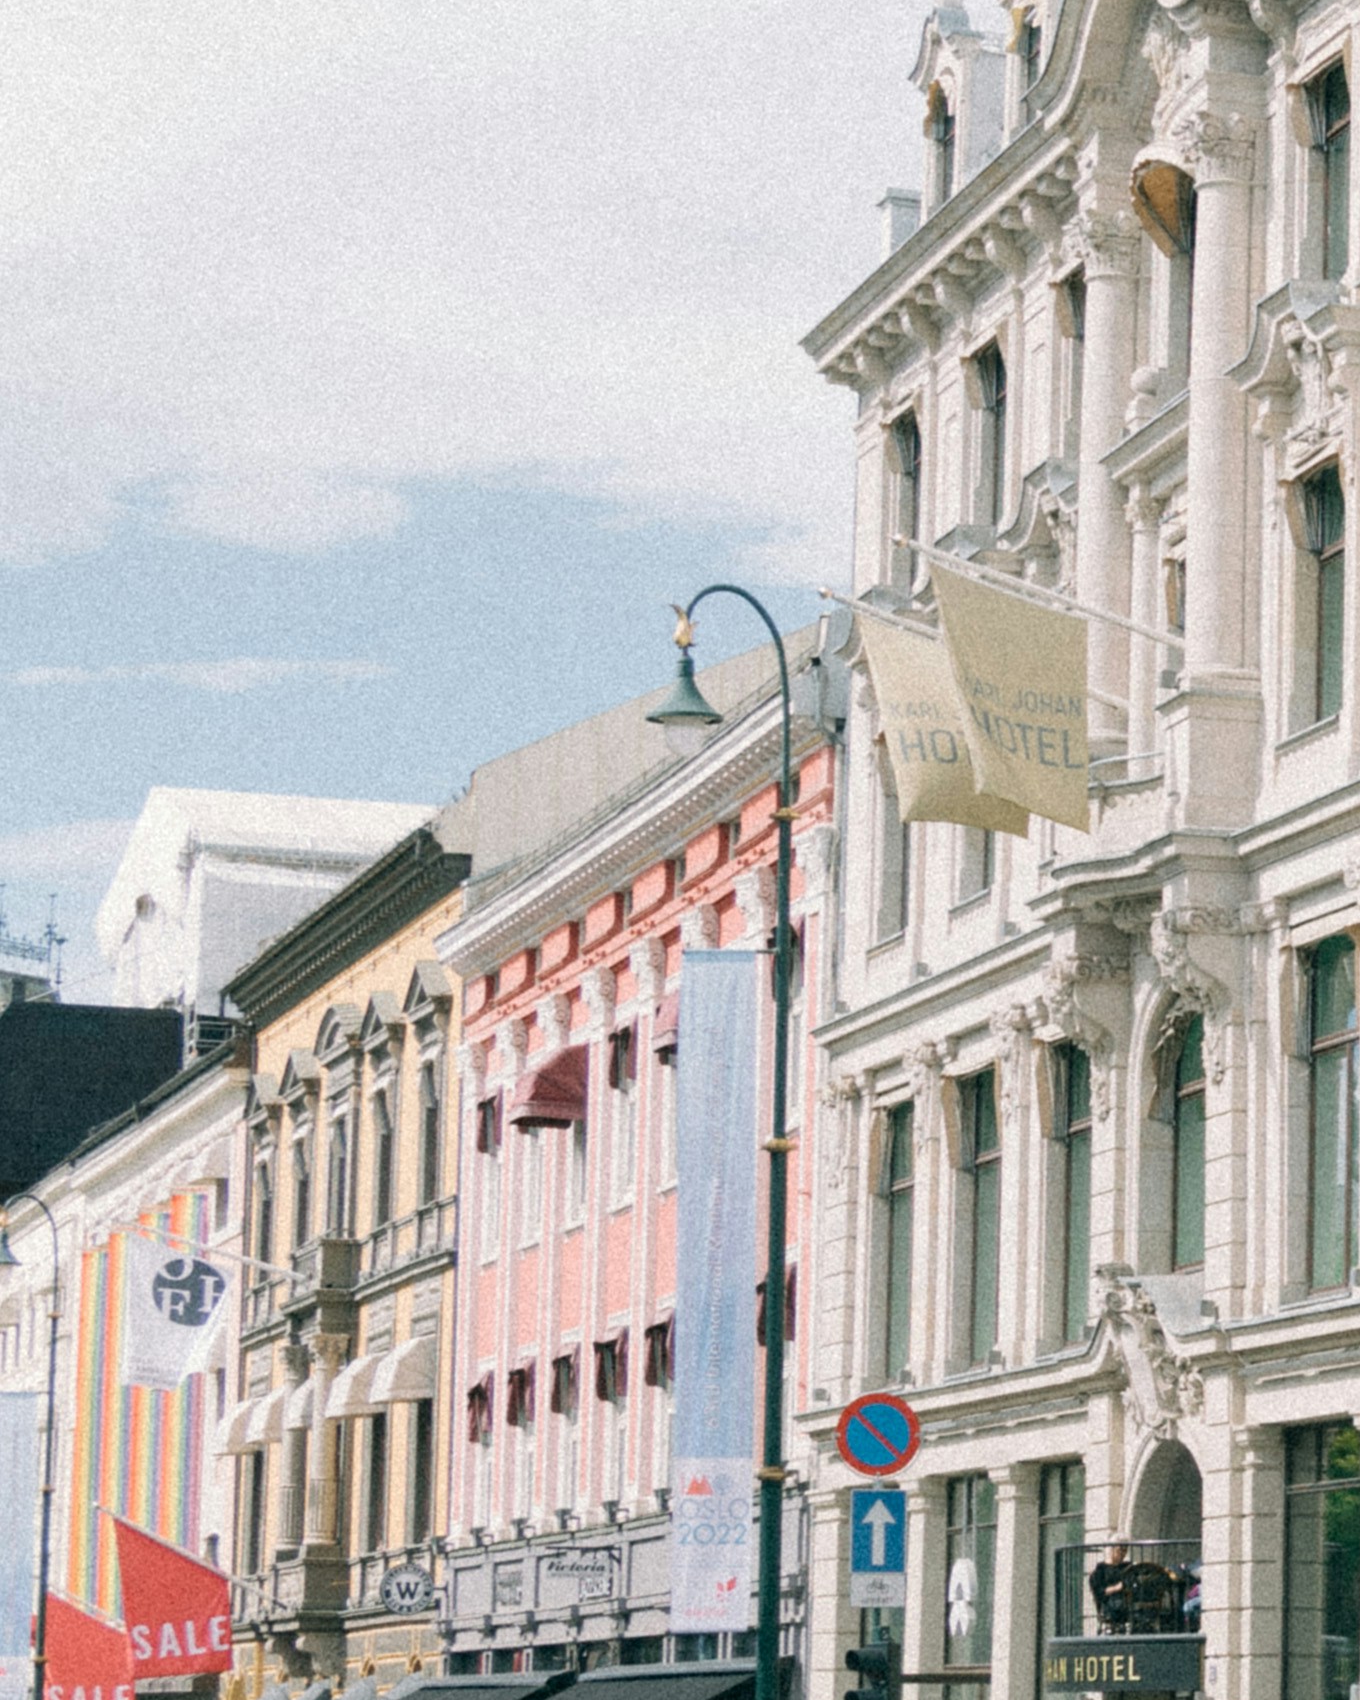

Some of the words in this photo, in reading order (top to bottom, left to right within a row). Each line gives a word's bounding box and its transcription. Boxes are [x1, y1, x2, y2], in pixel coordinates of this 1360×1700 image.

[679, 1498, 750, 1520] OSLO
[677, 1522, 748, 1546] 2022
[130, 1614, 231, 1661] SALE
[1074, 1655, 1141, 1682] HOTEL
